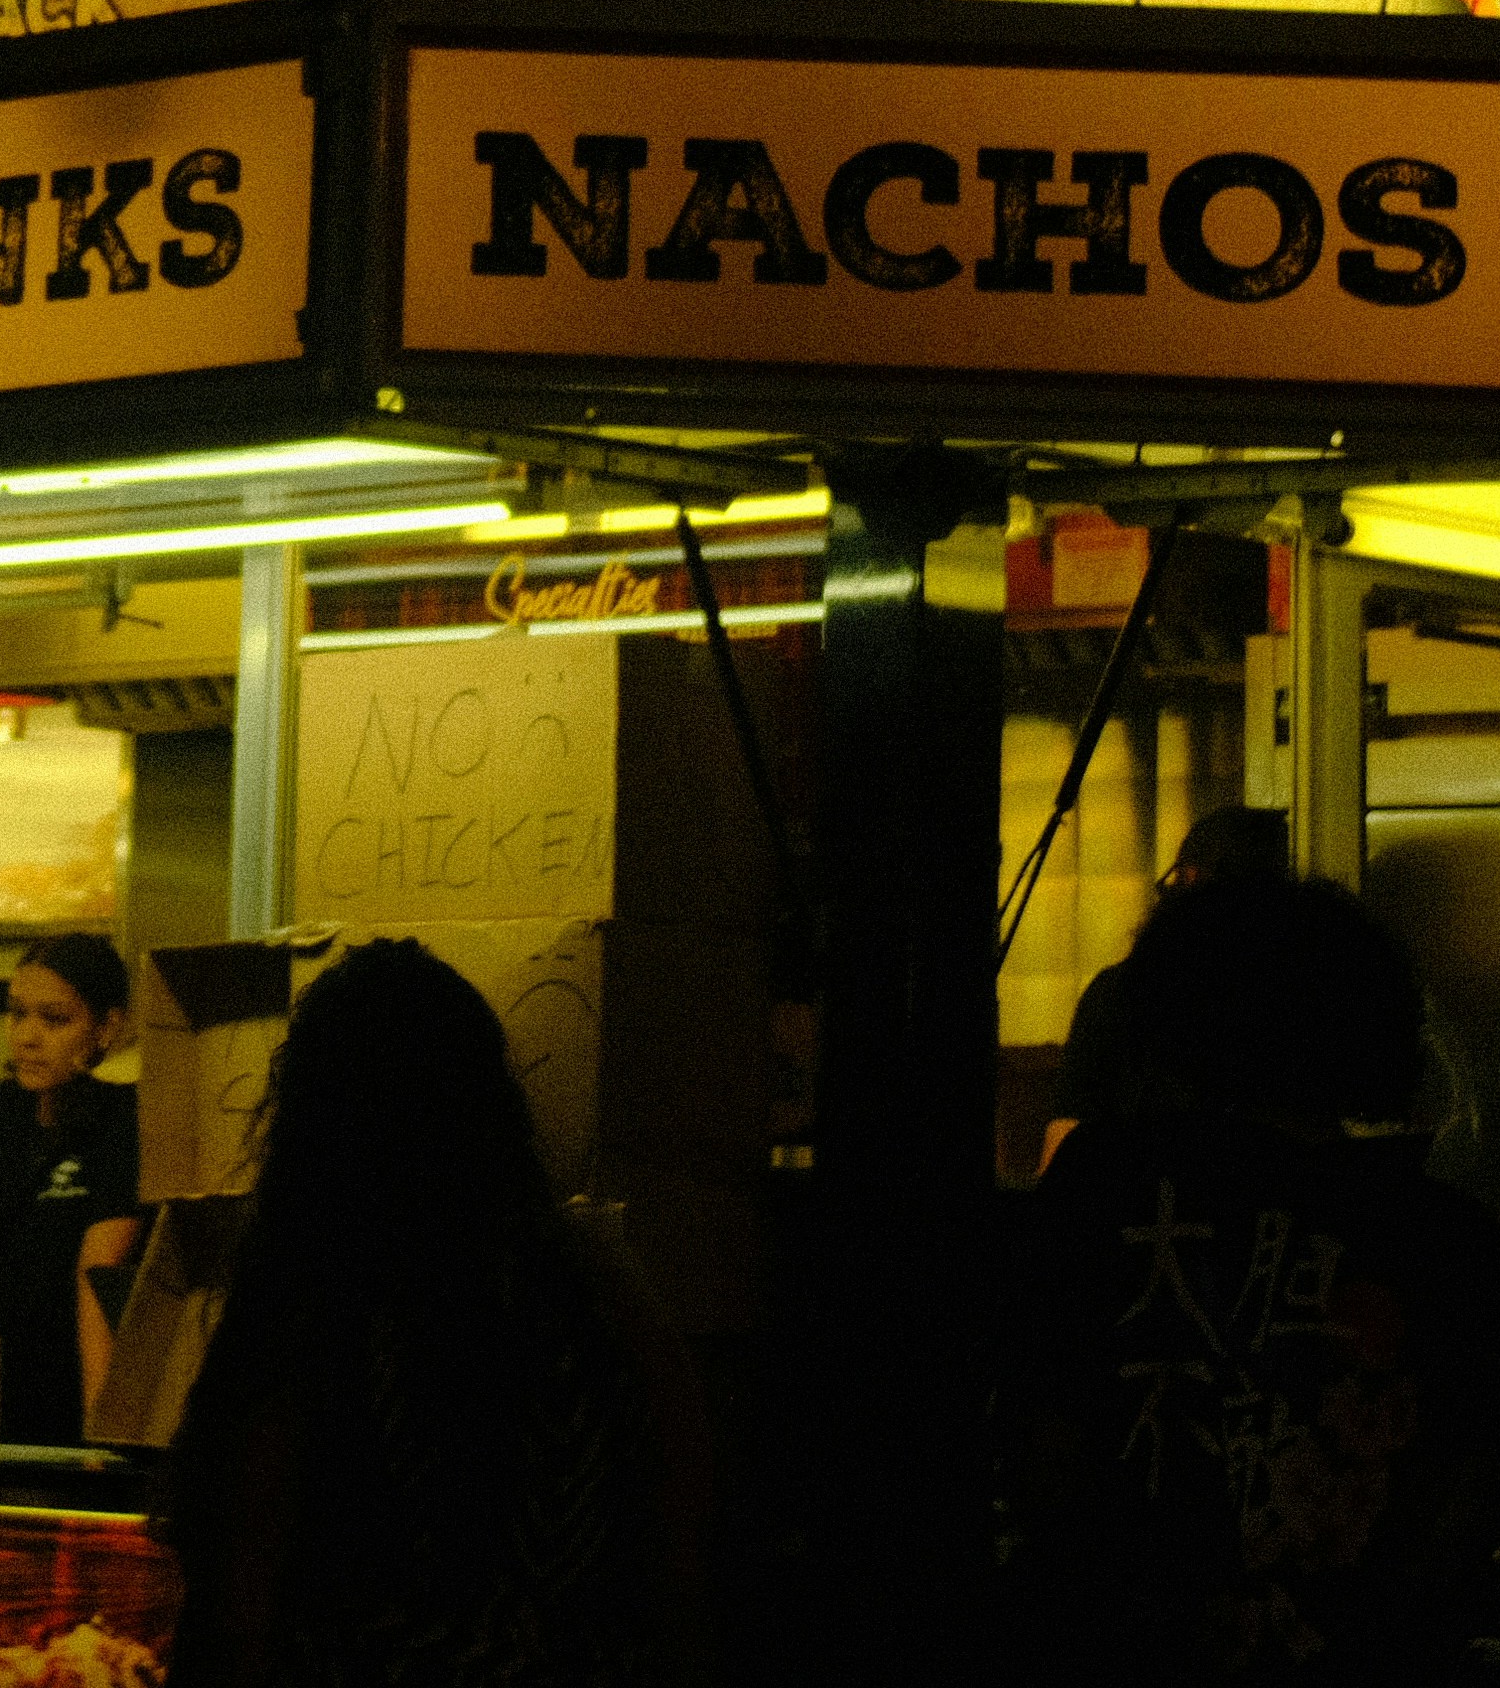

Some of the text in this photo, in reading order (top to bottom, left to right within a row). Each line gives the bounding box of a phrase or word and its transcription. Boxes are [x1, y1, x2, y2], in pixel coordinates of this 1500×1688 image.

[471, 129, 1468, 308] NACHOS
[485, 552, 662, 630] Specialties
[346, 687, 490, 800] NO
